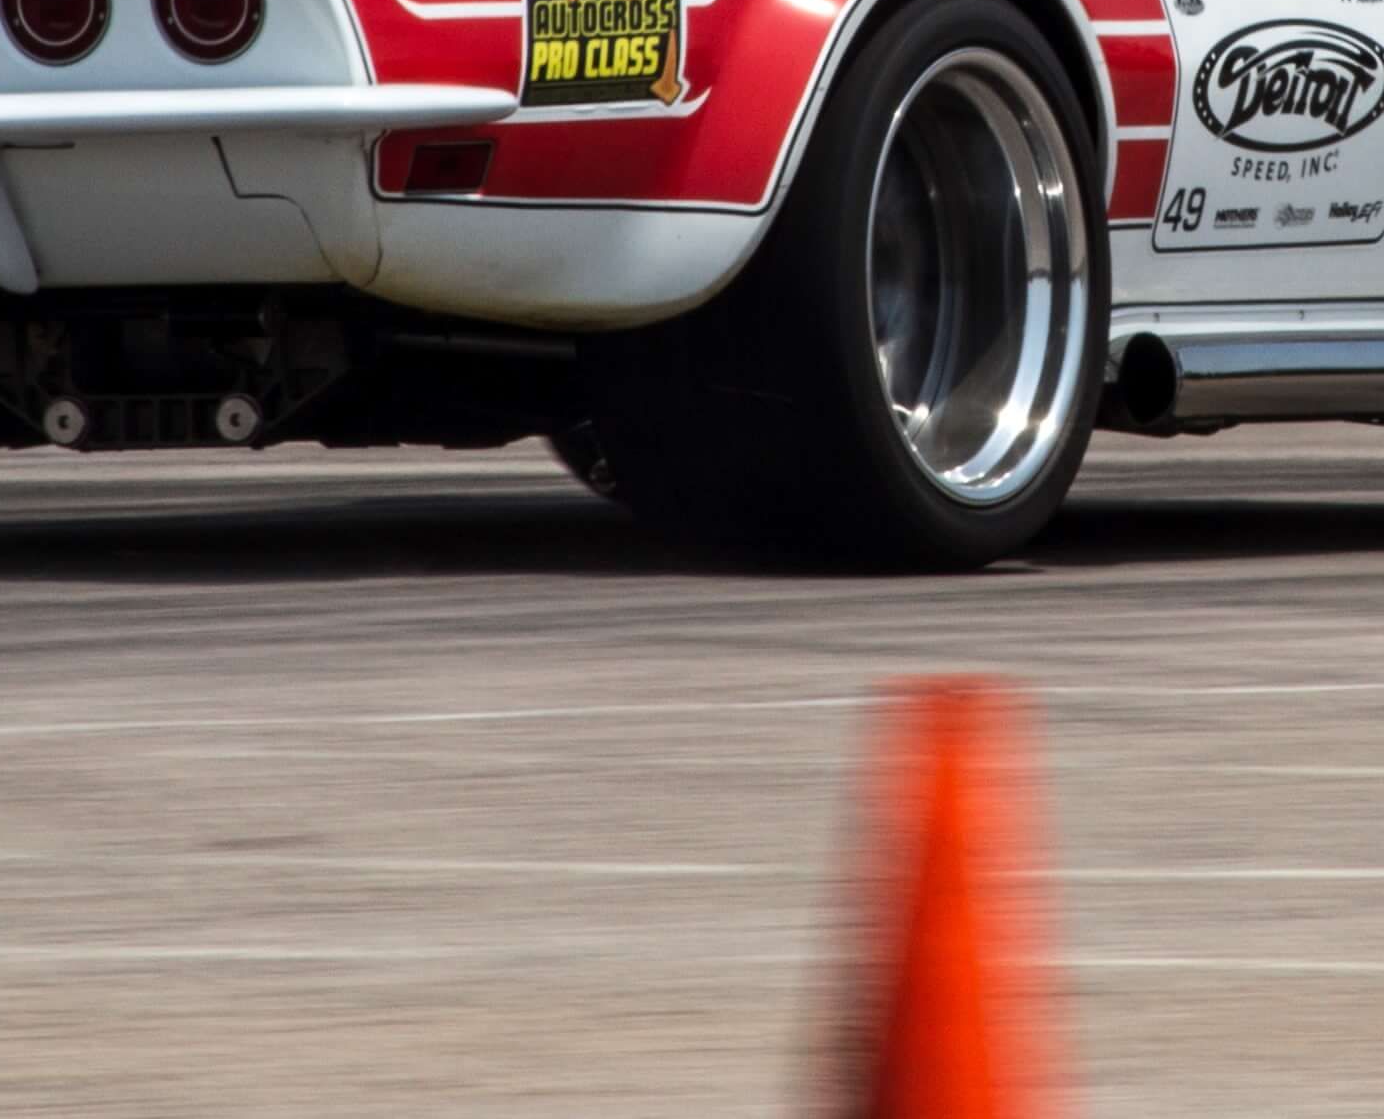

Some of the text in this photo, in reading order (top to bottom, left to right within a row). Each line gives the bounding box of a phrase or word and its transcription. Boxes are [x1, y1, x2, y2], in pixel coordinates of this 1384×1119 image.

[530, 35, 661, 82] PRO CLASS
[1163, 186, 1207, 232] 49
